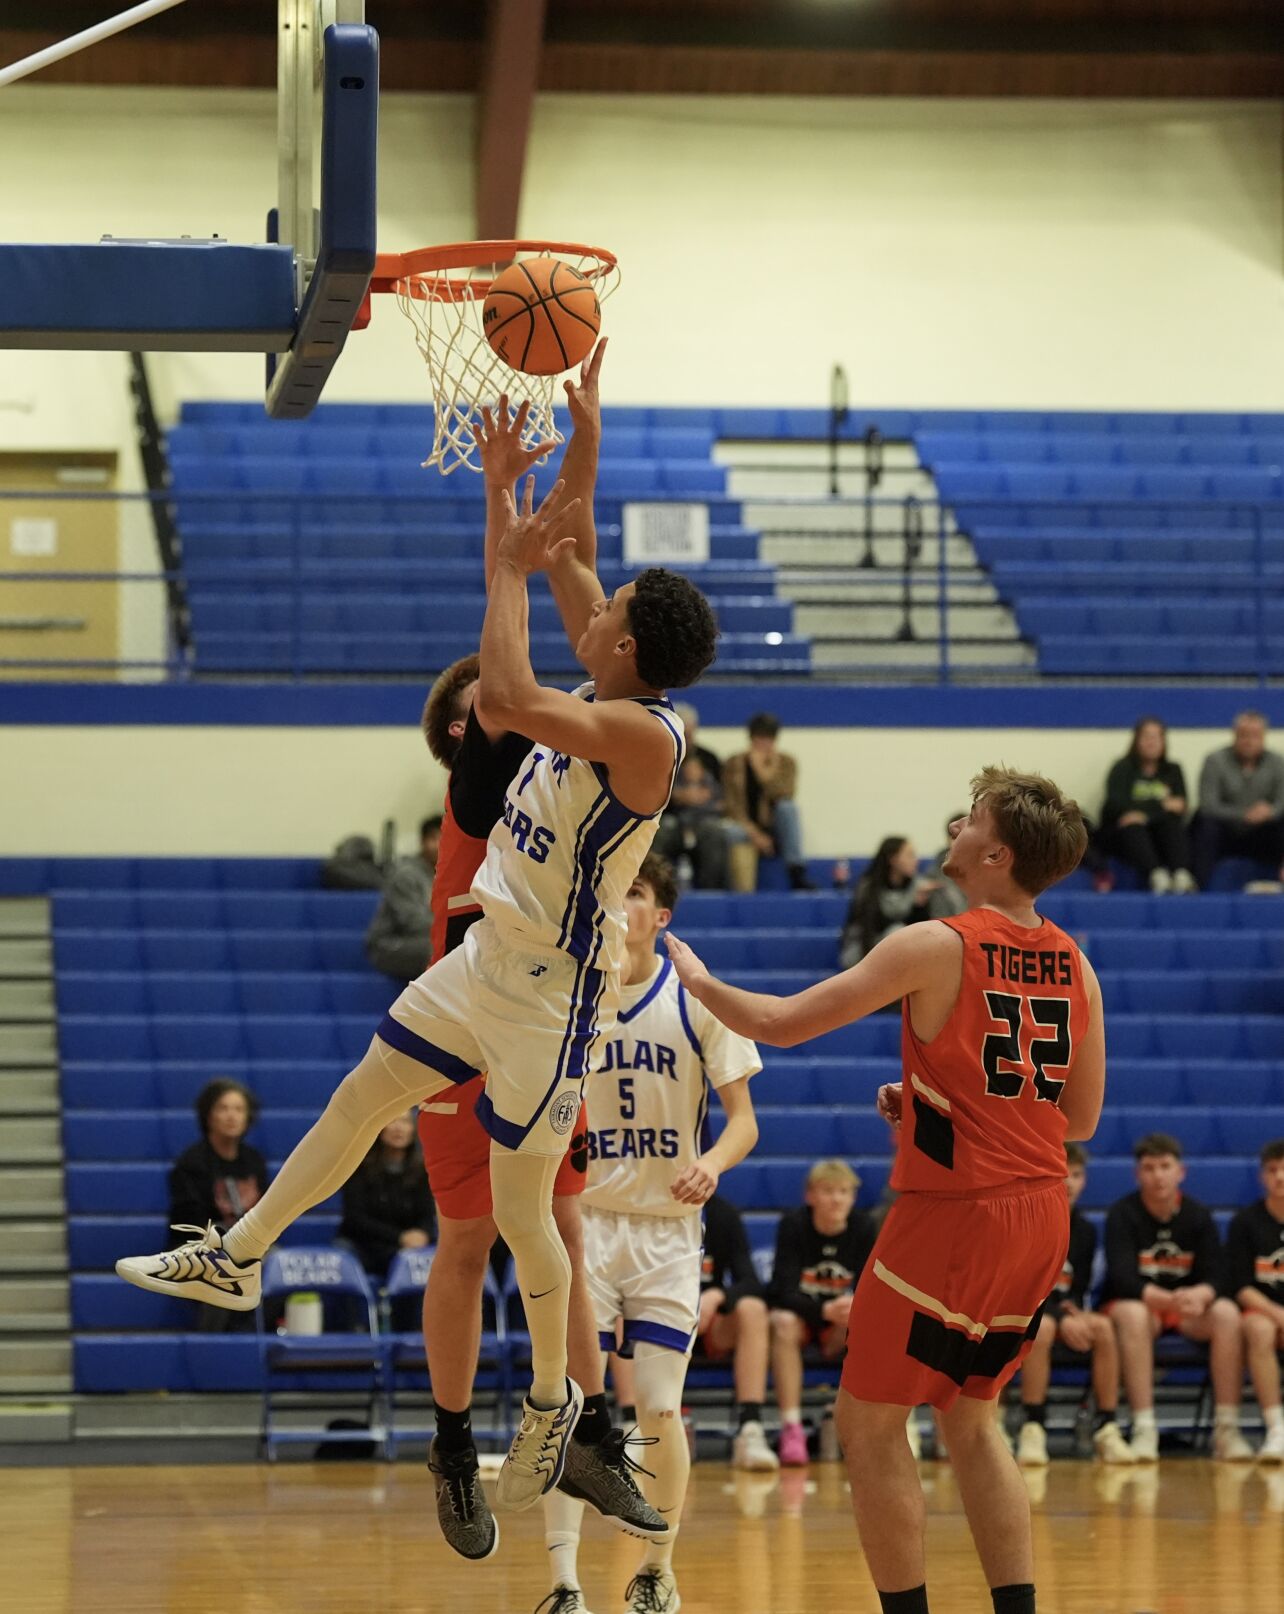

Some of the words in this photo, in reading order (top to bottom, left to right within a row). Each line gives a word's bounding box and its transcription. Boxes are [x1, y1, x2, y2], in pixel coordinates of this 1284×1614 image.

[979, 943, 1072, 986] TIGERS
[980, 989, 1073, 1105] 22
[618, 1078, 635, 1120] 5
[587, 1128, 679, 1161] BEARS
